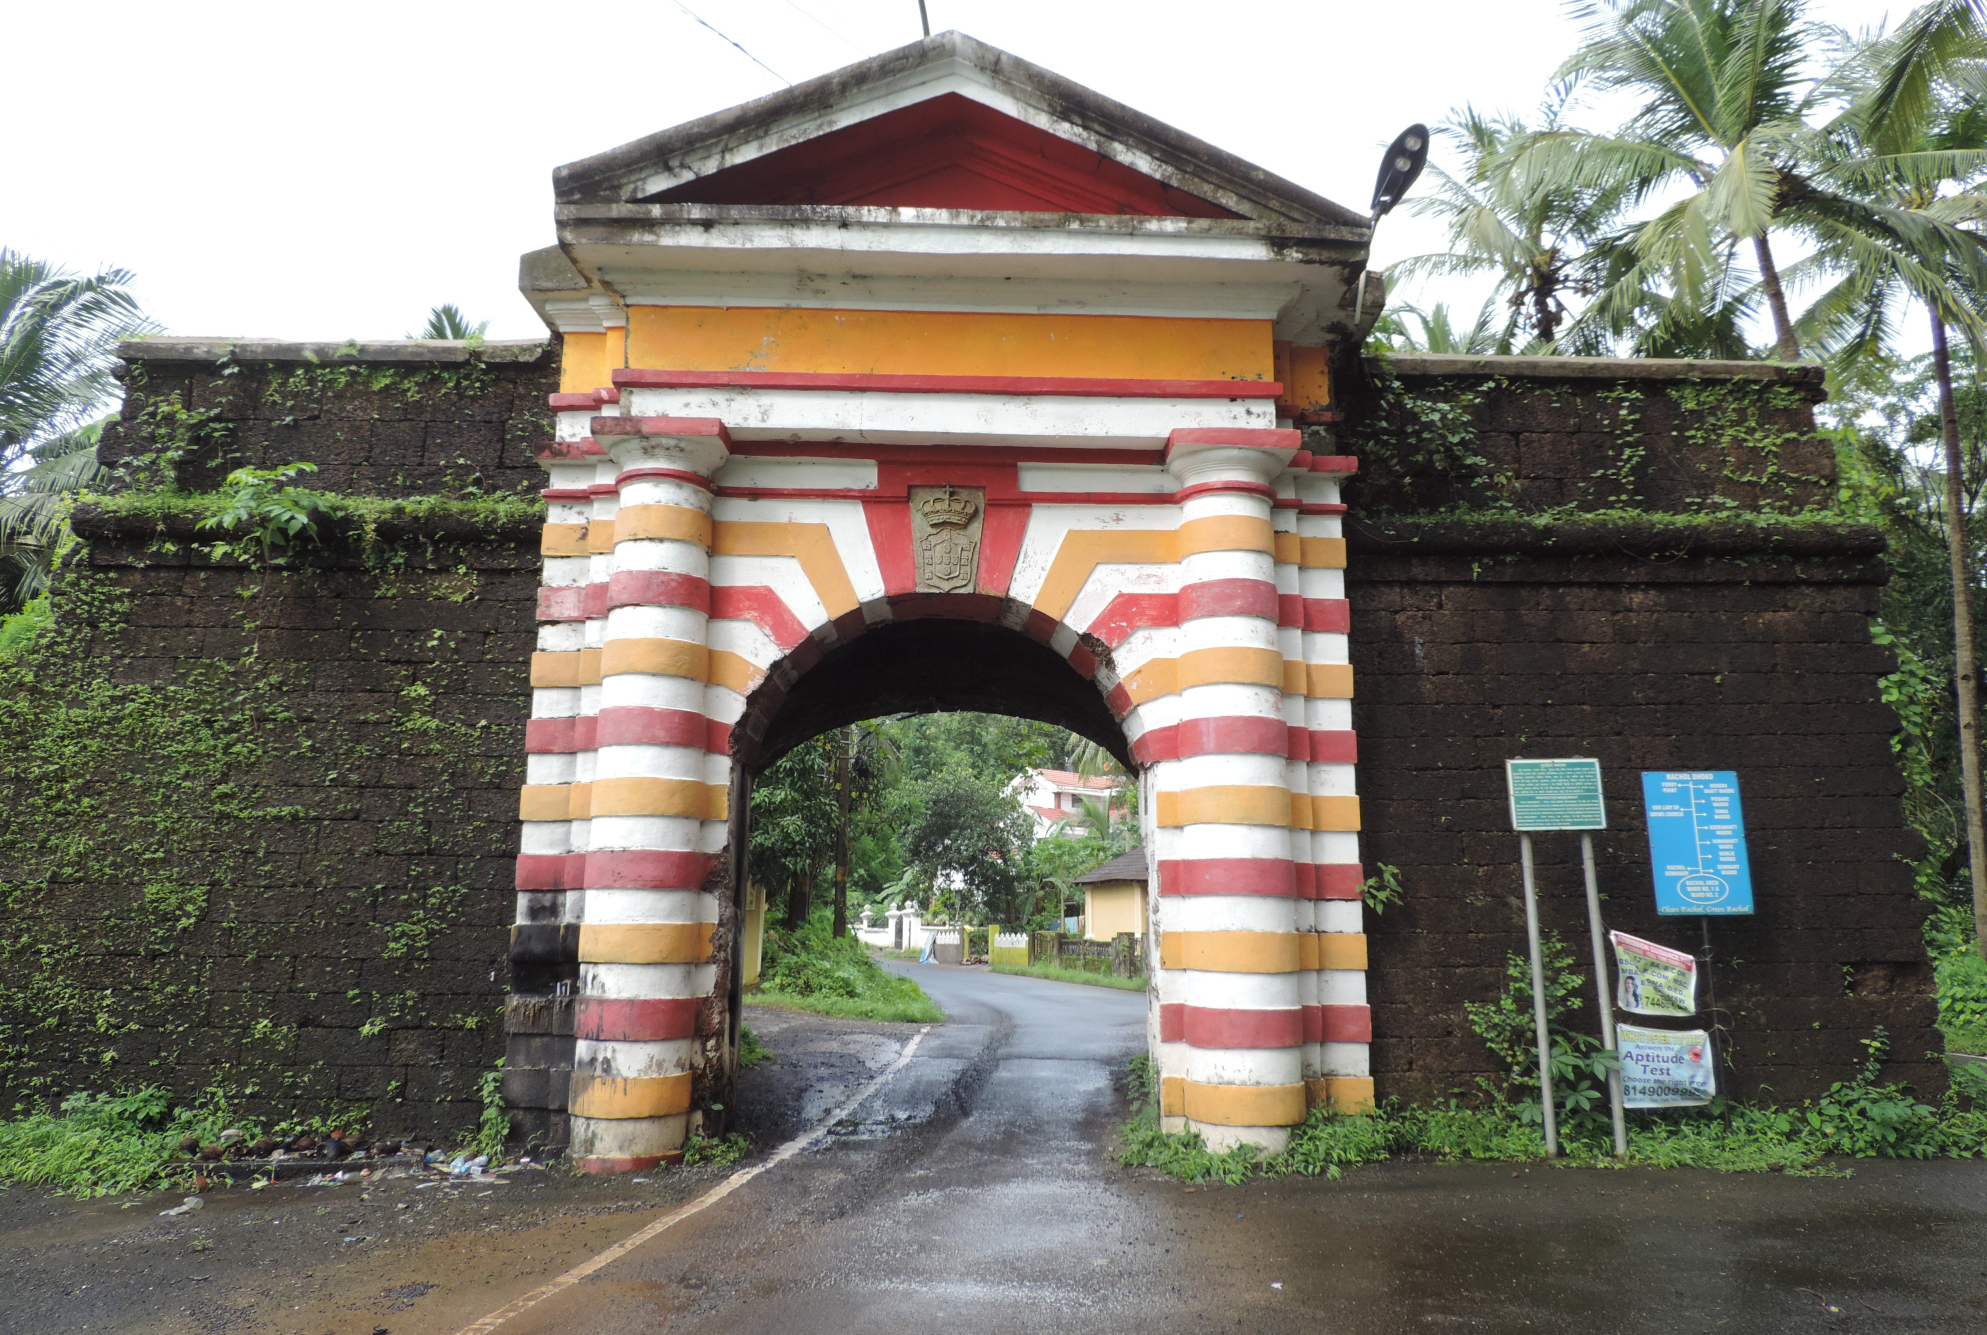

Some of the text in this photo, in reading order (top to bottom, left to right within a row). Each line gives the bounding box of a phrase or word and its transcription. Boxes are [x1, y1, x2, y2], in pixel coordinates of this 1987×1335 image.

[1621, 1031, 1645, 1043] WHAT
[1647, 1032, 1671, 1044] AFTER
[1623, 1050, 1685, 1065] Aptitude
[1640, 1064, 1671, 1076] Test
[1623, 1075, 1652, 1083] Choose
[1667, 1079, 1687, 1088] right
